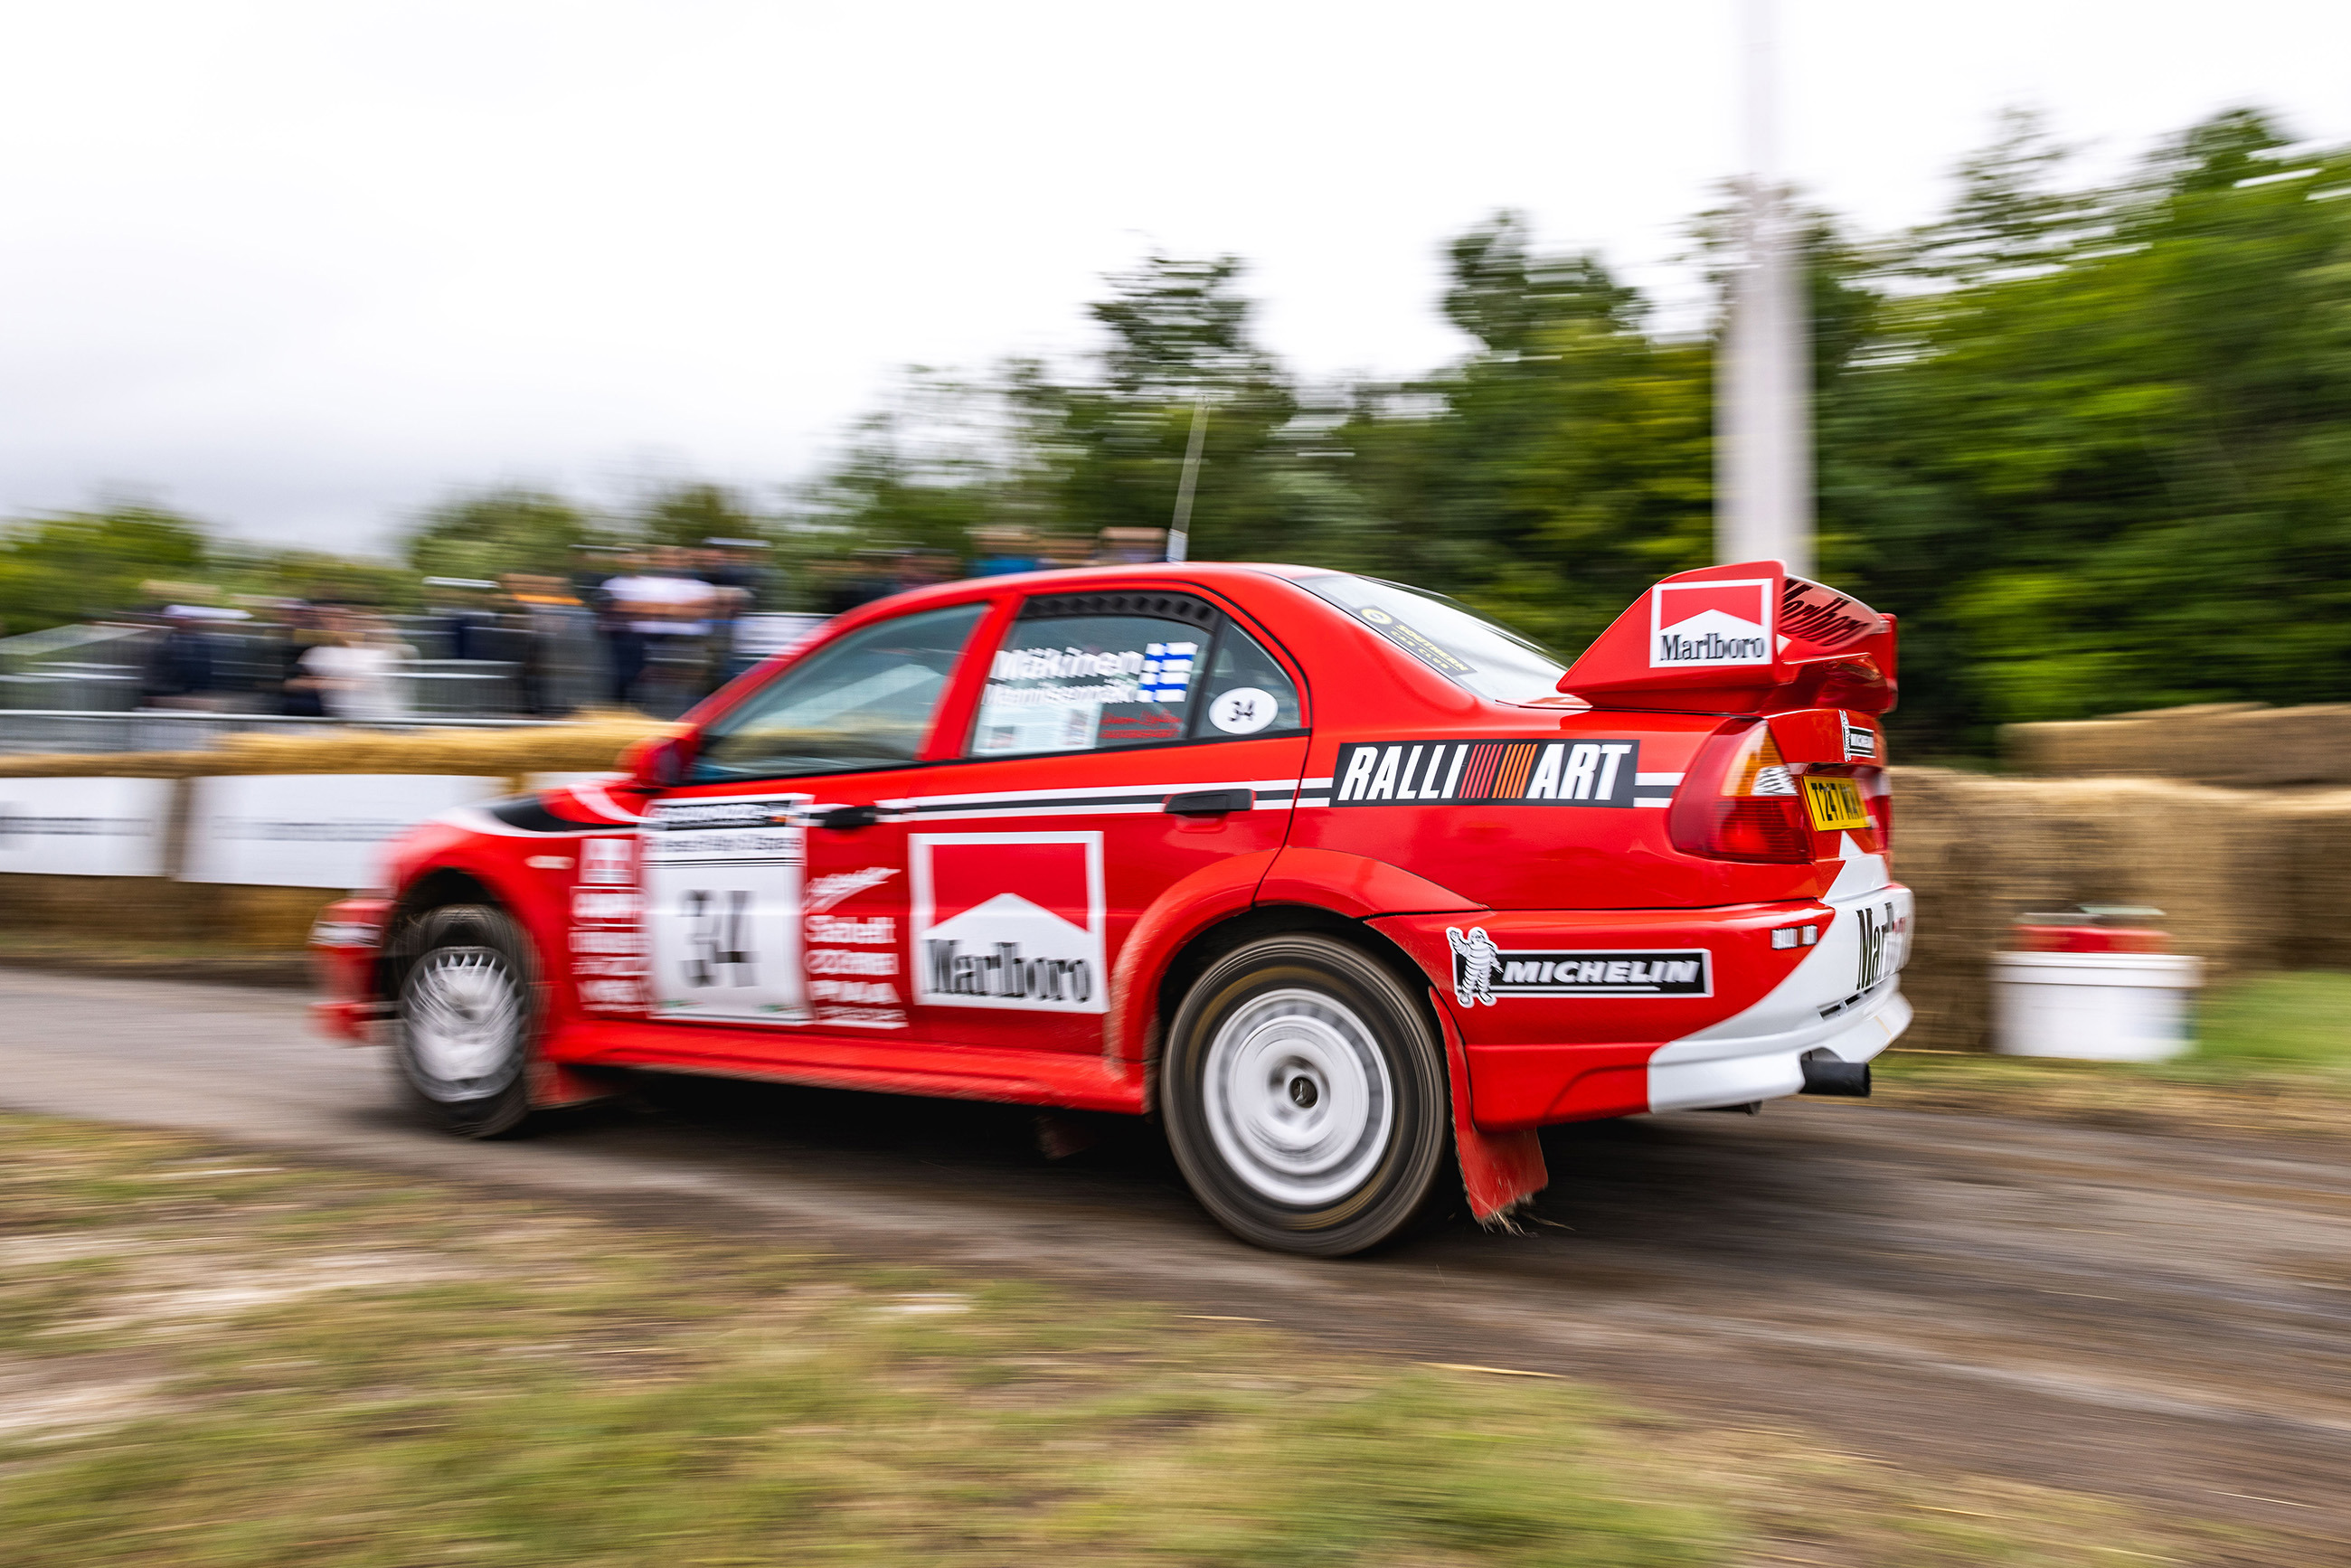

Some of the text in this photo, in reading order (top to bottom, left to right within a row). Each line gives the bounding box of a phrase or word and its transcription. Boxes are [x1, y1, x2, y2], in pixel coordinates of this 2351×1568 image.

[1659, 632, 1765, 661] Marlboro
[1228, 699, 1255, 722] 34
[1337, 743, 1632, 801] RALLI ART
[676, 888, 760, 988] 34
[922, 939, 1093, 1004] Marlboro
[1502, 960, 1701, 984] MICHELIN
